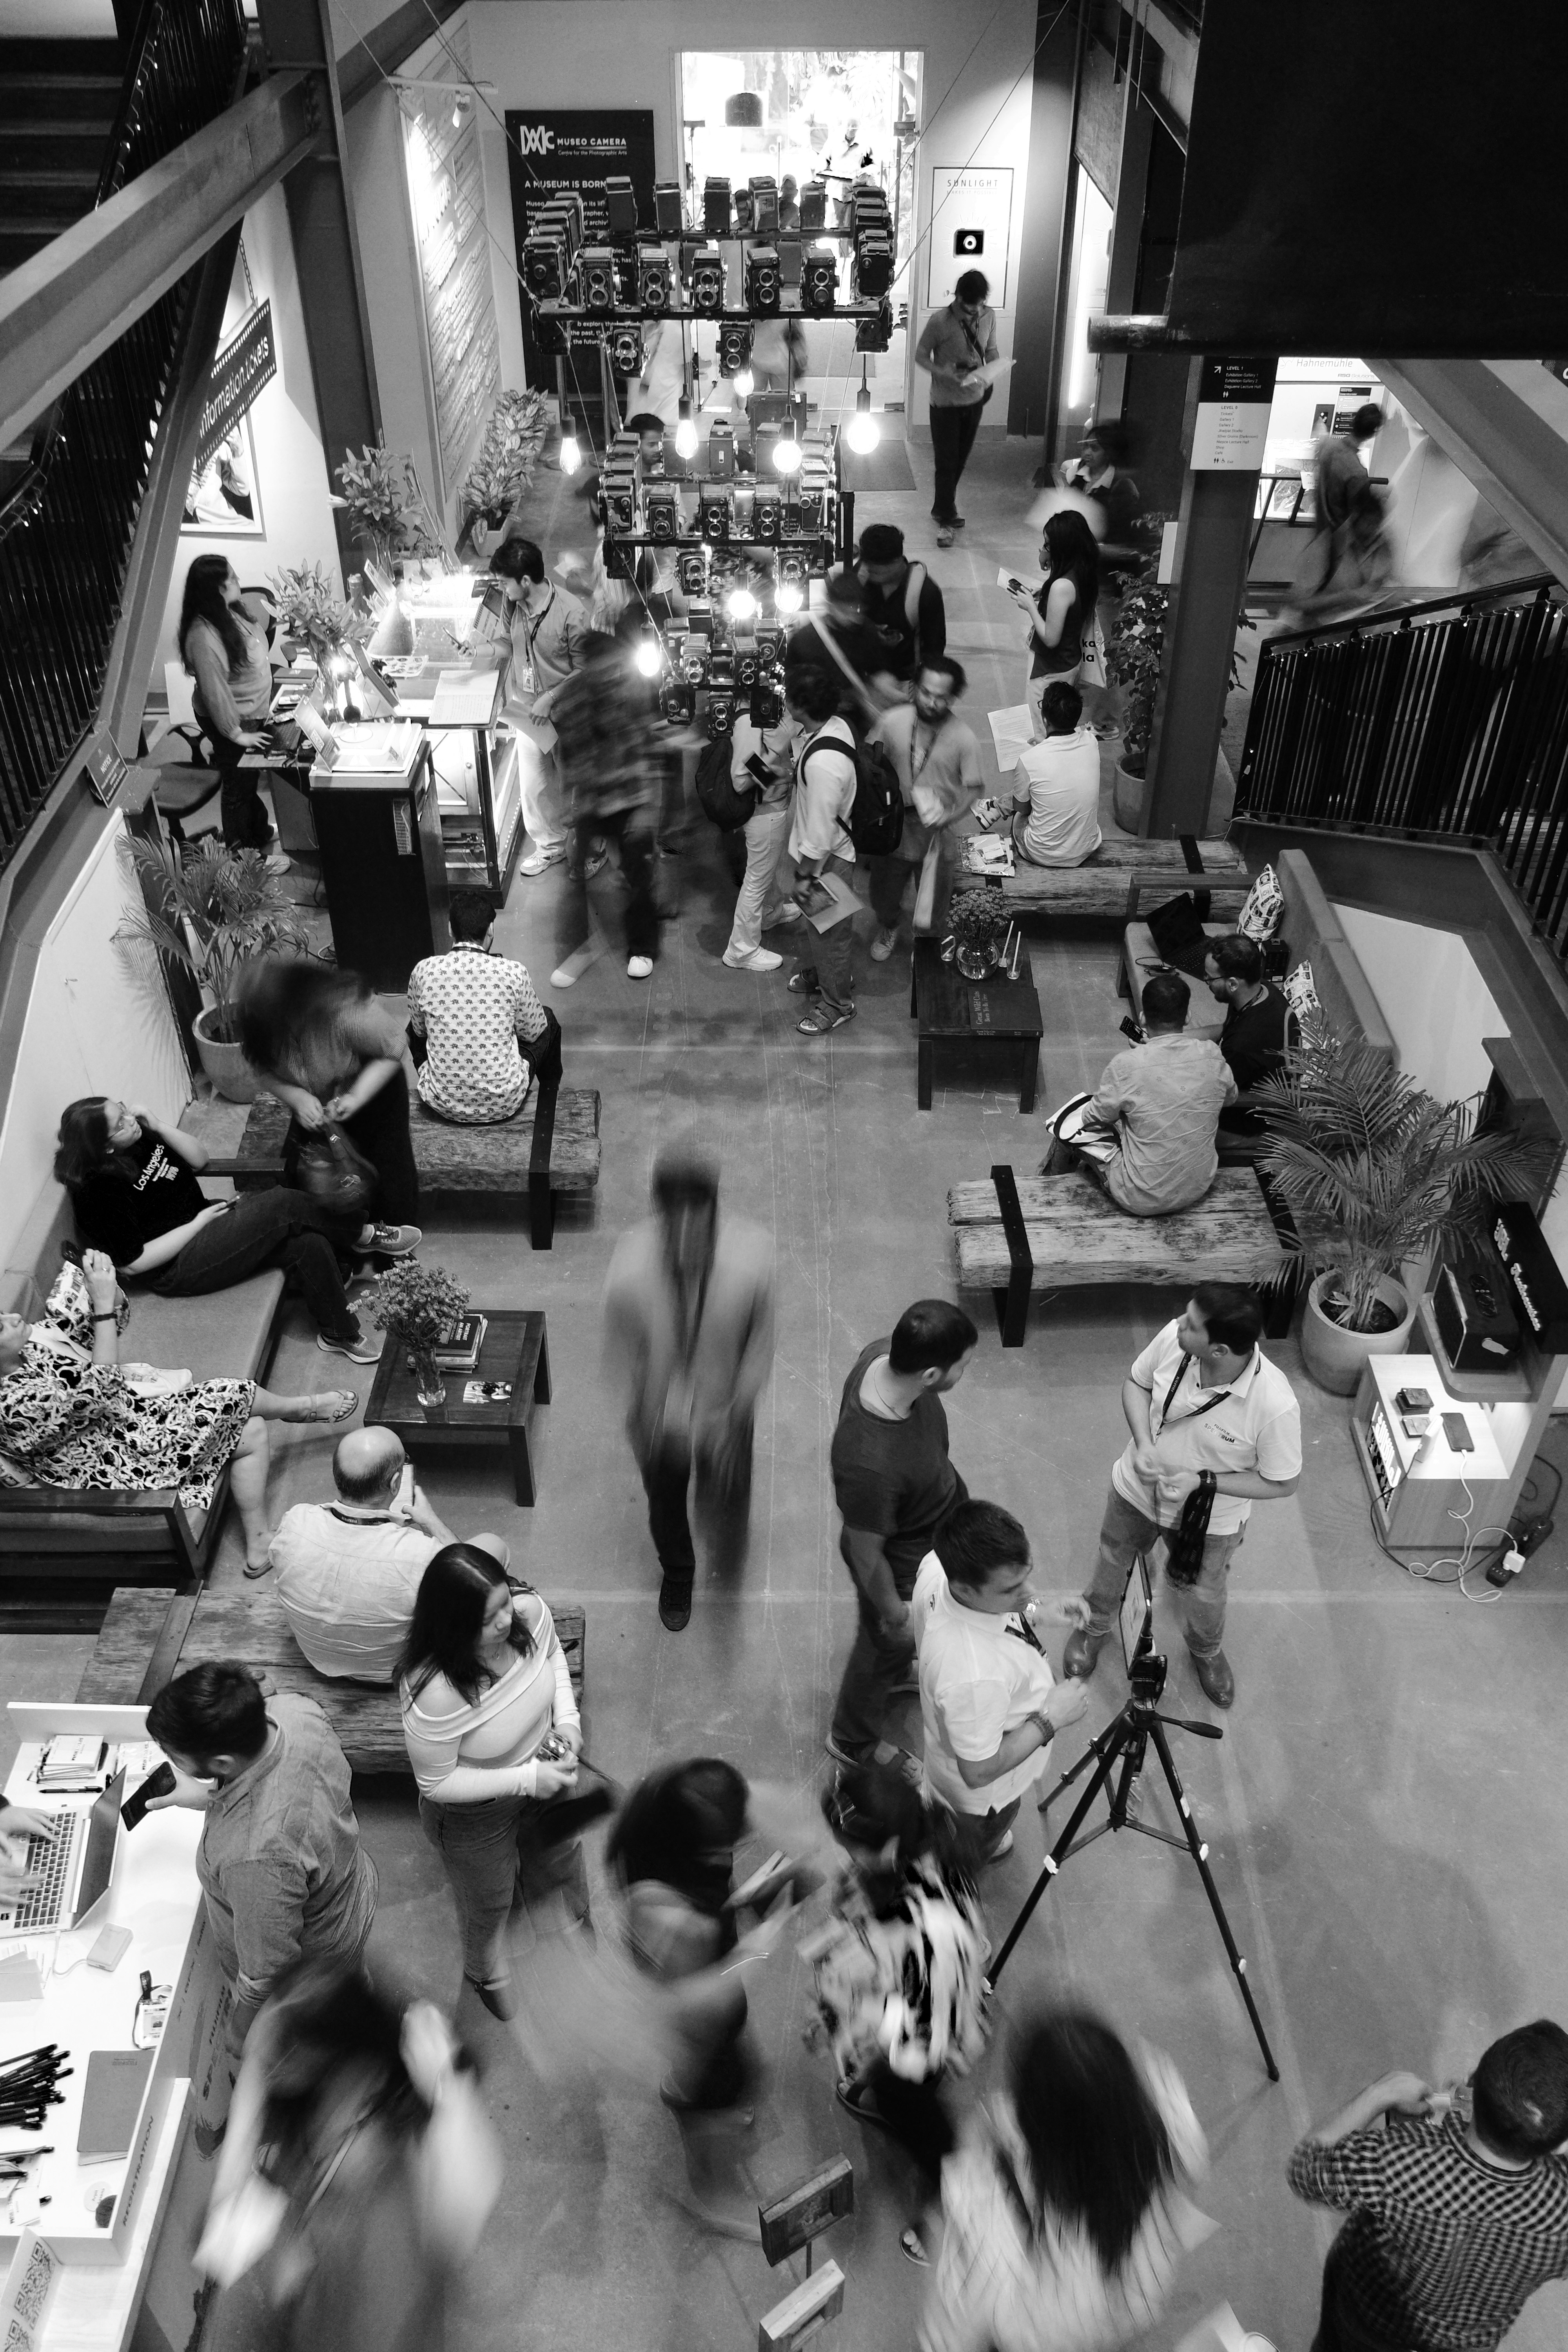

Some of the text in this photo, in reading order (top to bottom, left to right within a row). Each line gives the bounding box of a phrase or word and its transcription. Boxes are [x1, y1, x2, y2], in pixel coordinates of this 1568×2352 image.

[582, 180, 607, 189] BORN
[1297, 359, 1353, 367] Hahnemühle
[1082, 639, 1096, 648] ka
[1083, 652, 1094, 662] la
[100, 753, 113, 775] NOTICE
[133, 1174, 150, 1191] Los
[142, 1143, 165, 1176] Angeles
[463, 1323, 471, 1341] PORTRAIT
[1204, 1423, 1236, 1443] SPETRUM
[1214, 1424, 1230, 1436] FUJIFILM
[123, 2115, 154, 2227] REGISTRATION
